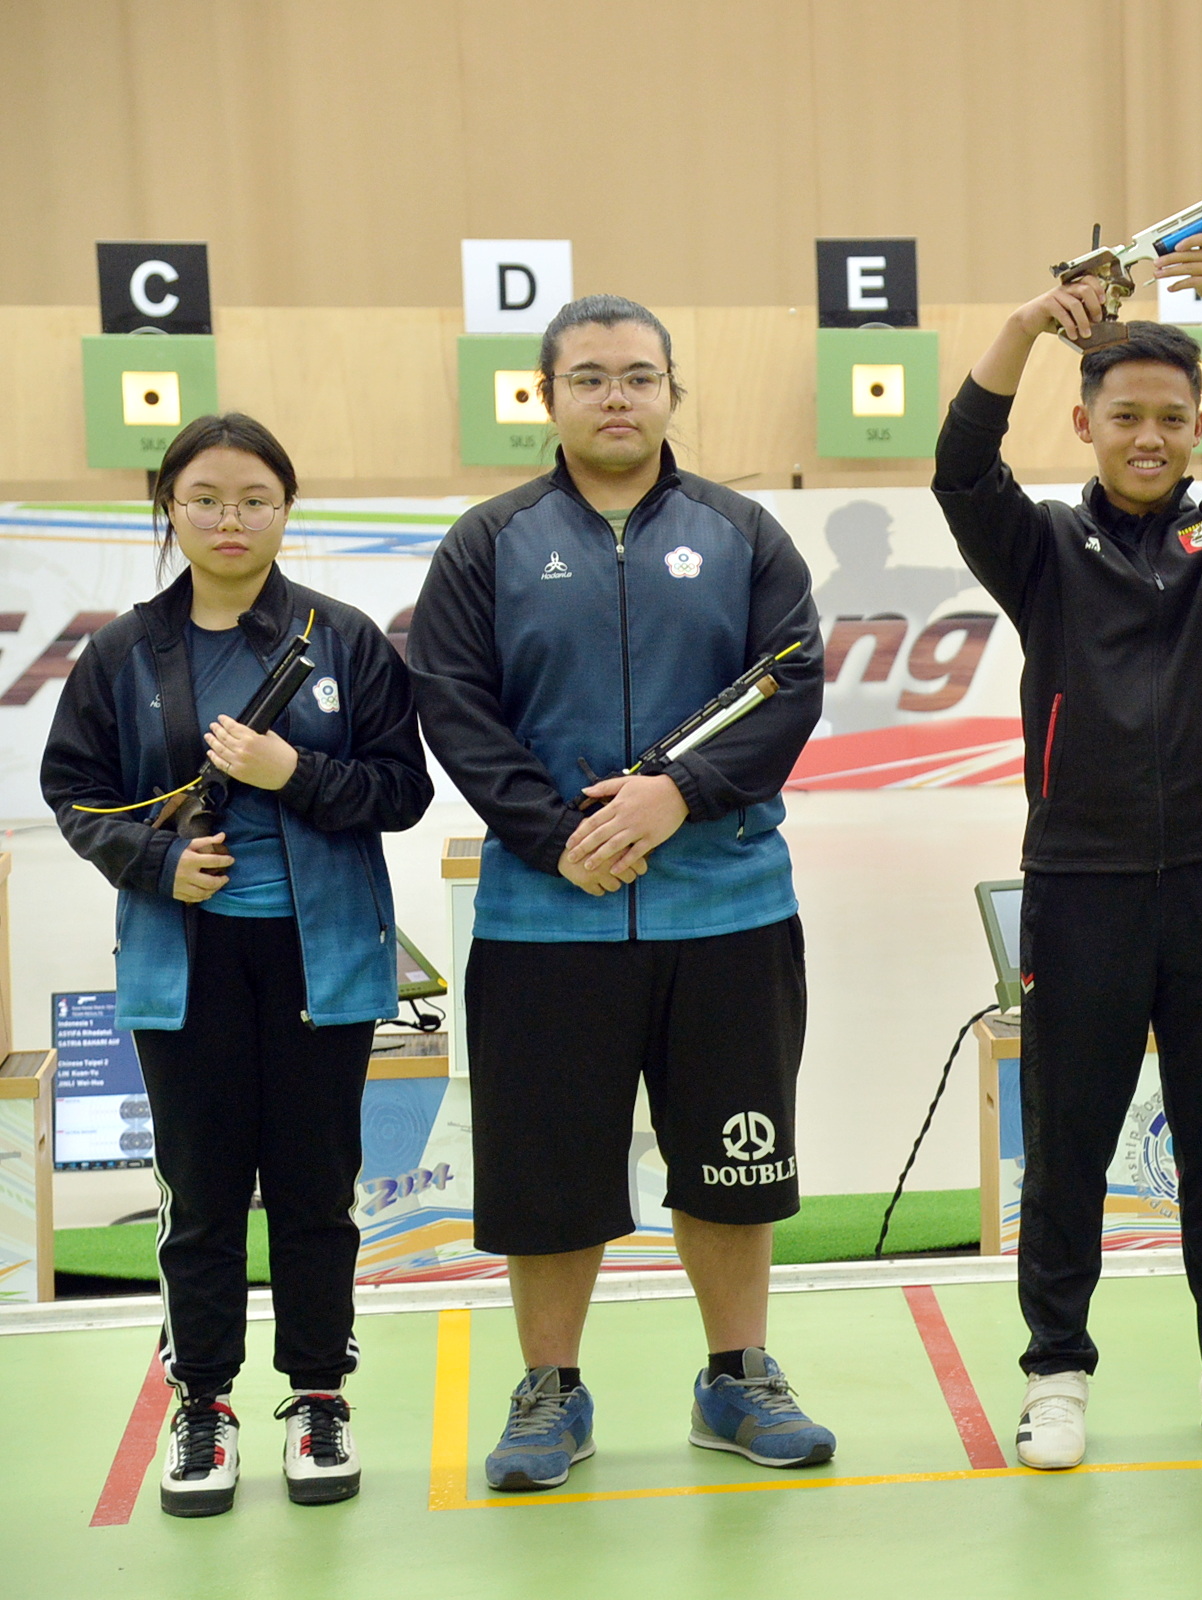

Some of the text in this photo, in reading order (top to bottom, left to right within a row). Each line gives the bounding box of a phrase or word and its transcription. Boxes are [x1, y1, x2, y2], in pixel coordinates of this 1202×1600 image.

[129, 259, 180, 318] C
[497, 262, 537, 311] D
[846, 256, 889, 311] E
[361, 1162, 454, 1217] 2024
[701, 1155, 797, 1187] DOUBLE
